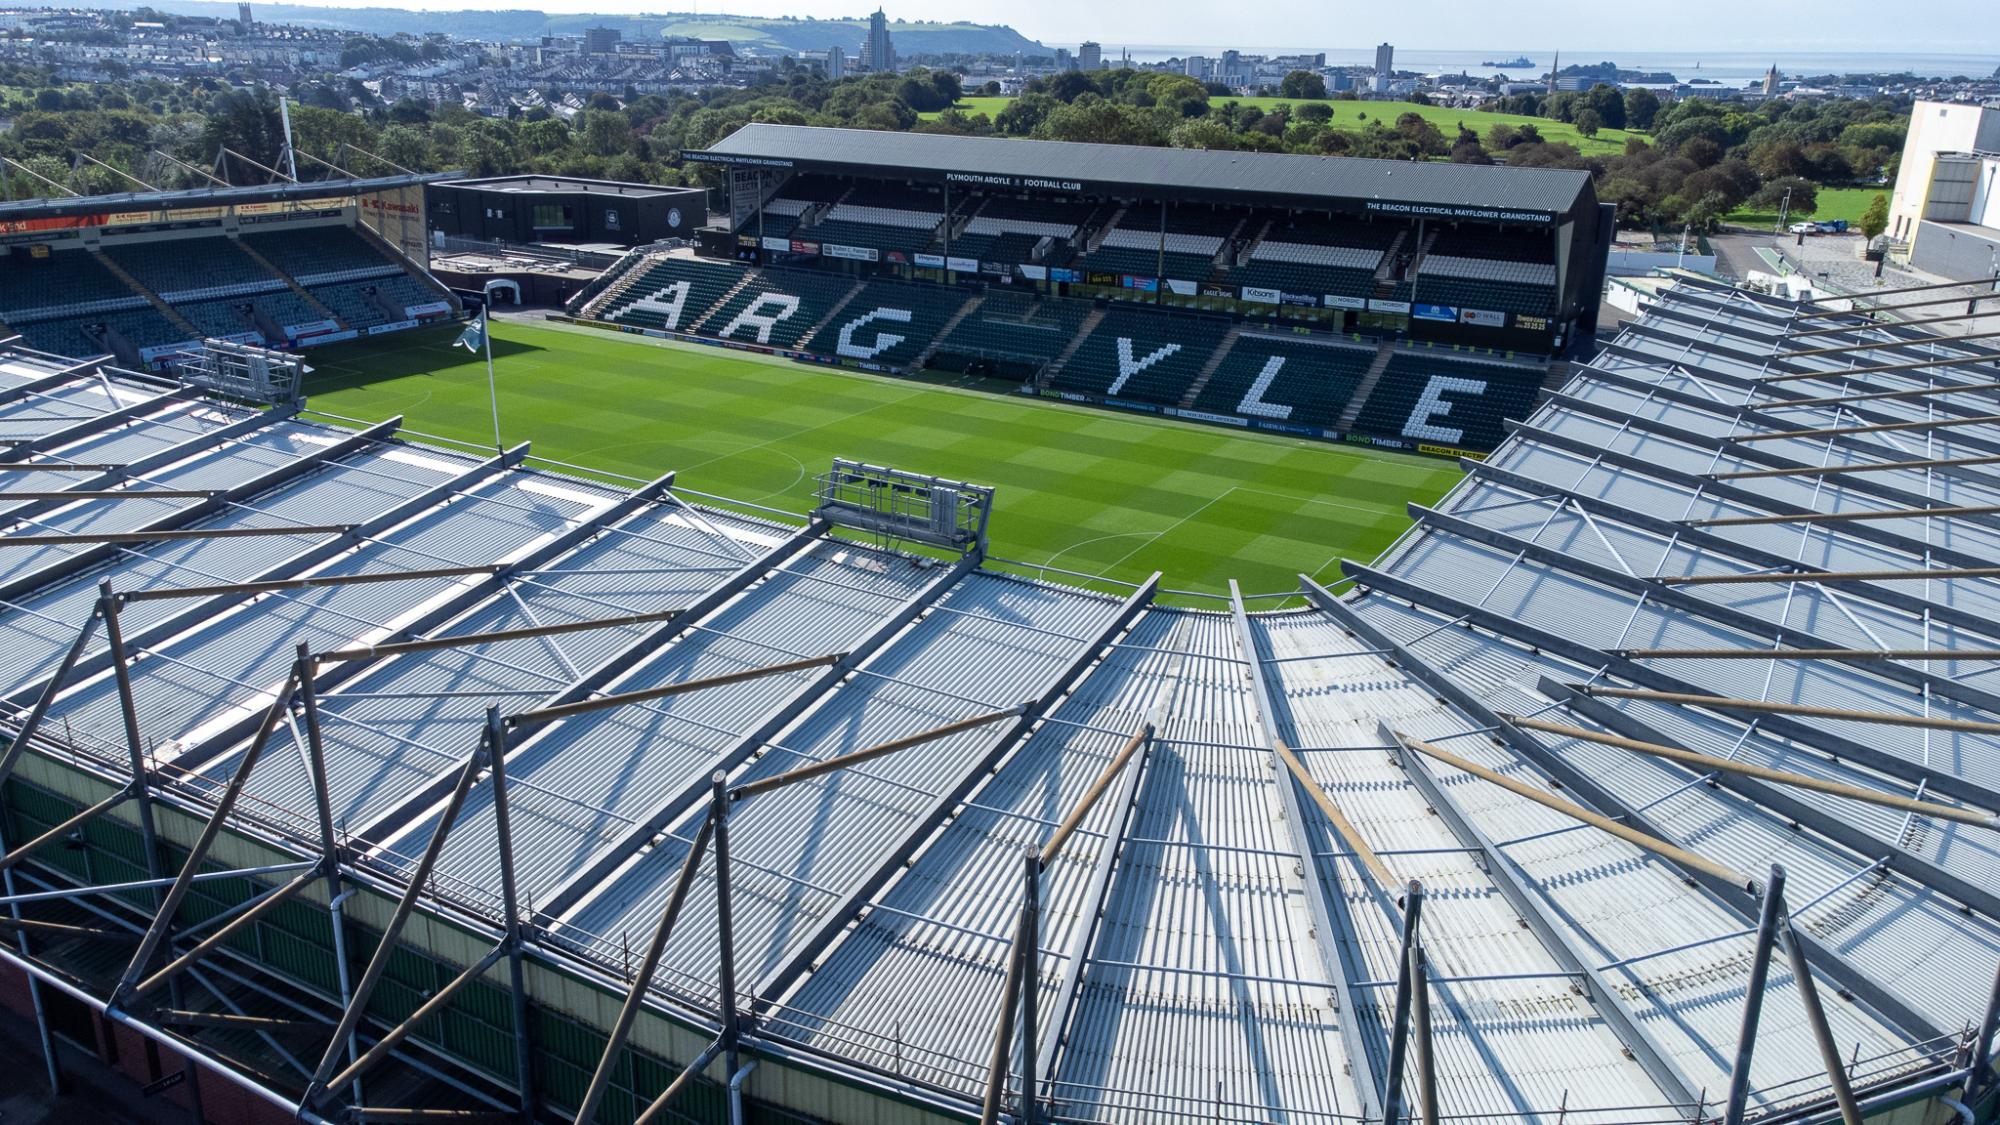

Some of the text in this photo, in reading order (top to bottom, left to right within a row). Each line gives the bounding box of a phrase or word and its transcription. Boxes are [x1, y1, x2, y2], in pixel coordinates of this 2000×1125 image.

[946, 173, 1081, 190] PLYMOUTH ARGYLE FOOTBALL CLUB
[381, 200, 419, 214] Kawasaki
[1367, 202, 1551, 222] THE BEACON ELECTRICAL MAYFLOWER GRANDSTAND
[1247, 288, 1275, 298] Kitsons
[859, 362, 880, 371] TIMBER
[1060, 392, 1085, 401] TIMBER
[1346, 434, 1402, 448] BOND TIMBER
[1420, 445, 1451, 455] BEACON
